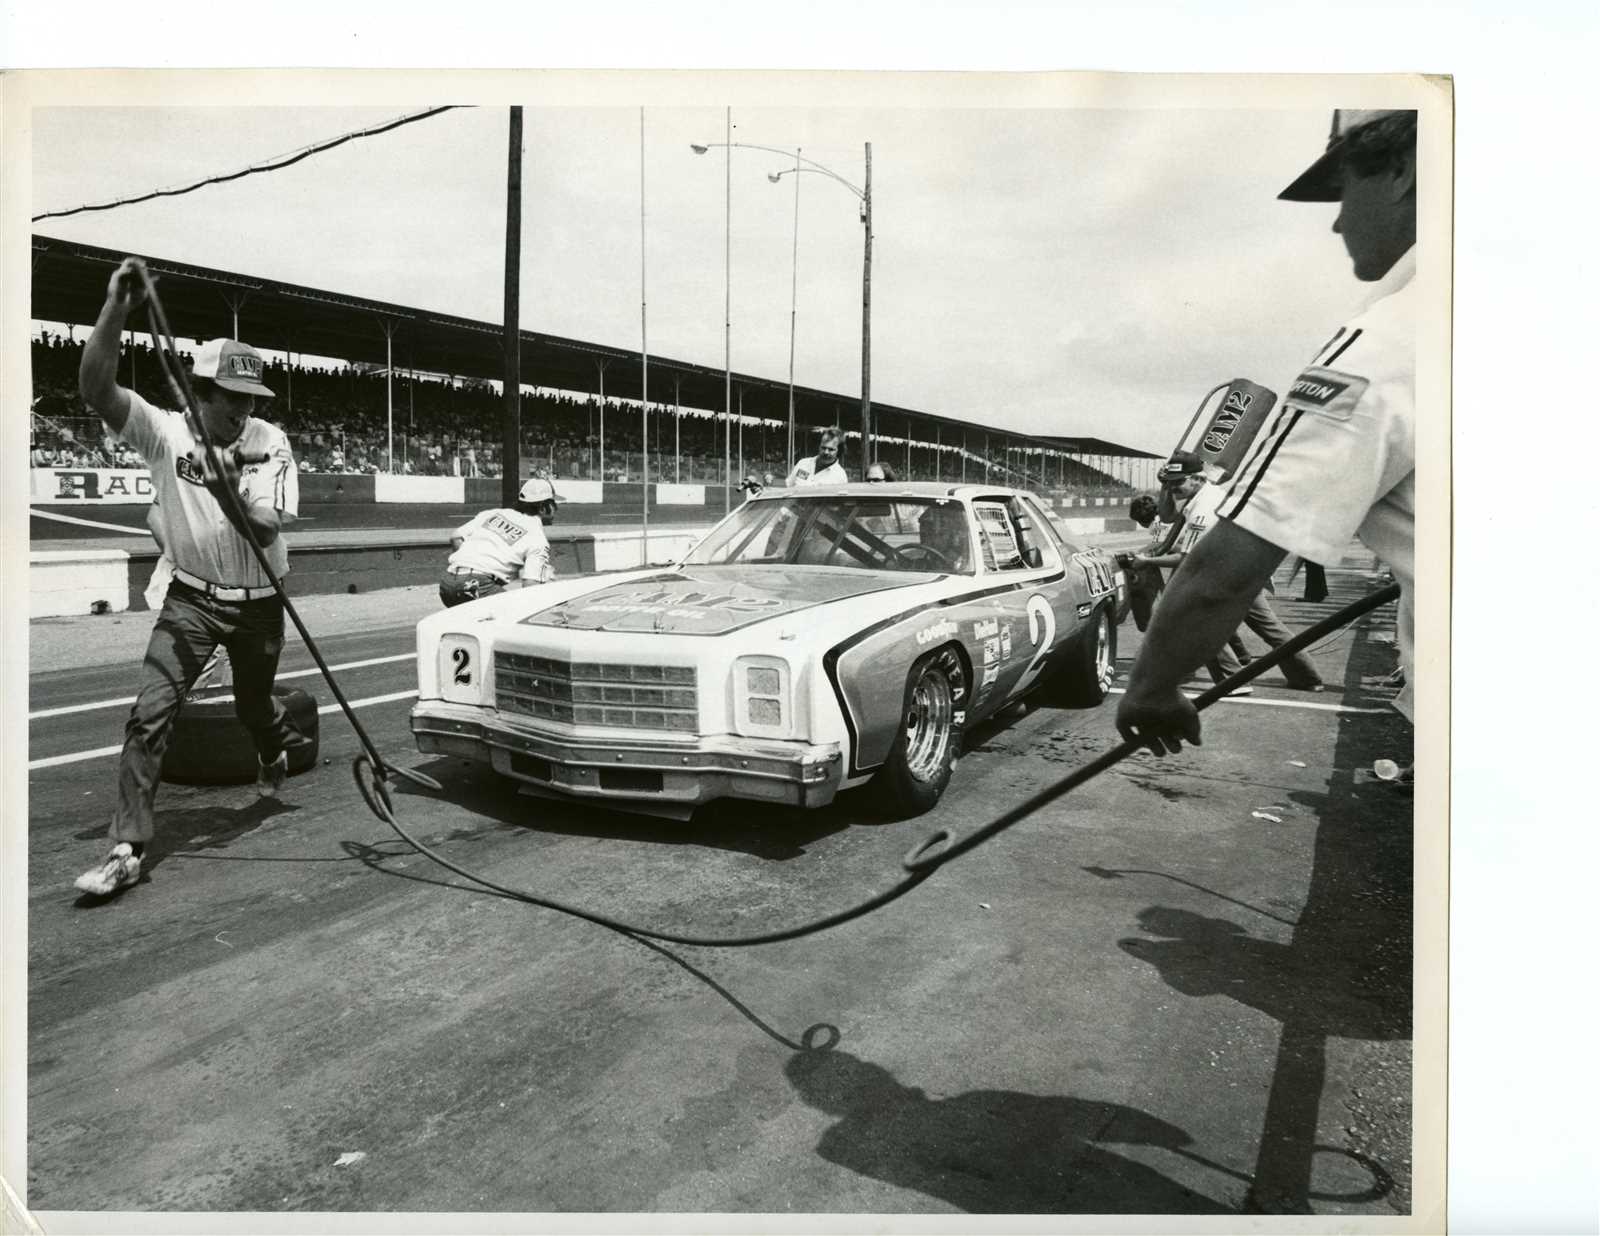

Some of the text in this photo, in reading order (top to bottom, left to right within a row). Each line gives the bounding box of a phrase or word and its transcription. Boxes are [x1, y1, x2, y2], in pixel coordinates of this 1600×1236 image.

[1204, 390, 1253, 454] CAM2
[452, 647, 472, 687] 2
[1007, 592, 1056, 698] 2
